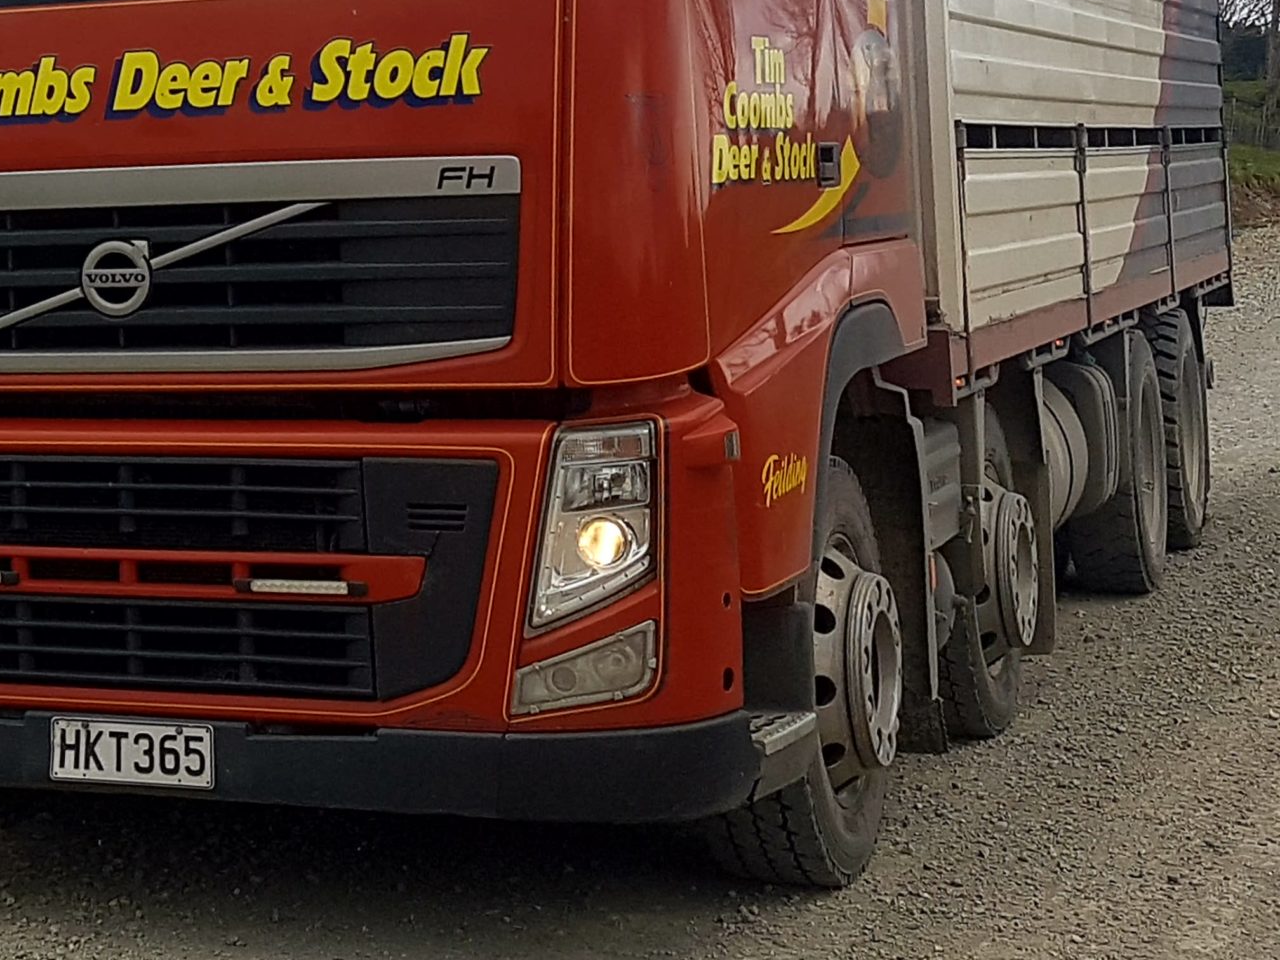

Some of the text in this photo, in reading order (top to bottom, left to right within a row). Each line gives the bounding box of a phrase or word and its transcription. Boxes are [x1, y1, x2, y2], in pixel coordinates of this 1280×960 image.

[110, 48, 249, 113] Deer
[254, 53, 292, 108] &
[313, 32, 489, 104] Stock
[751, 36, 785, 85] Tim
[724, 80, 794, 130] Coombs
[437, 166, 495, 190] FH
[712, 131, 816, 184] Deer & Stock
[86, 273, 146, 283] VOLVO
[59, 728, 205, 776] HKT365
